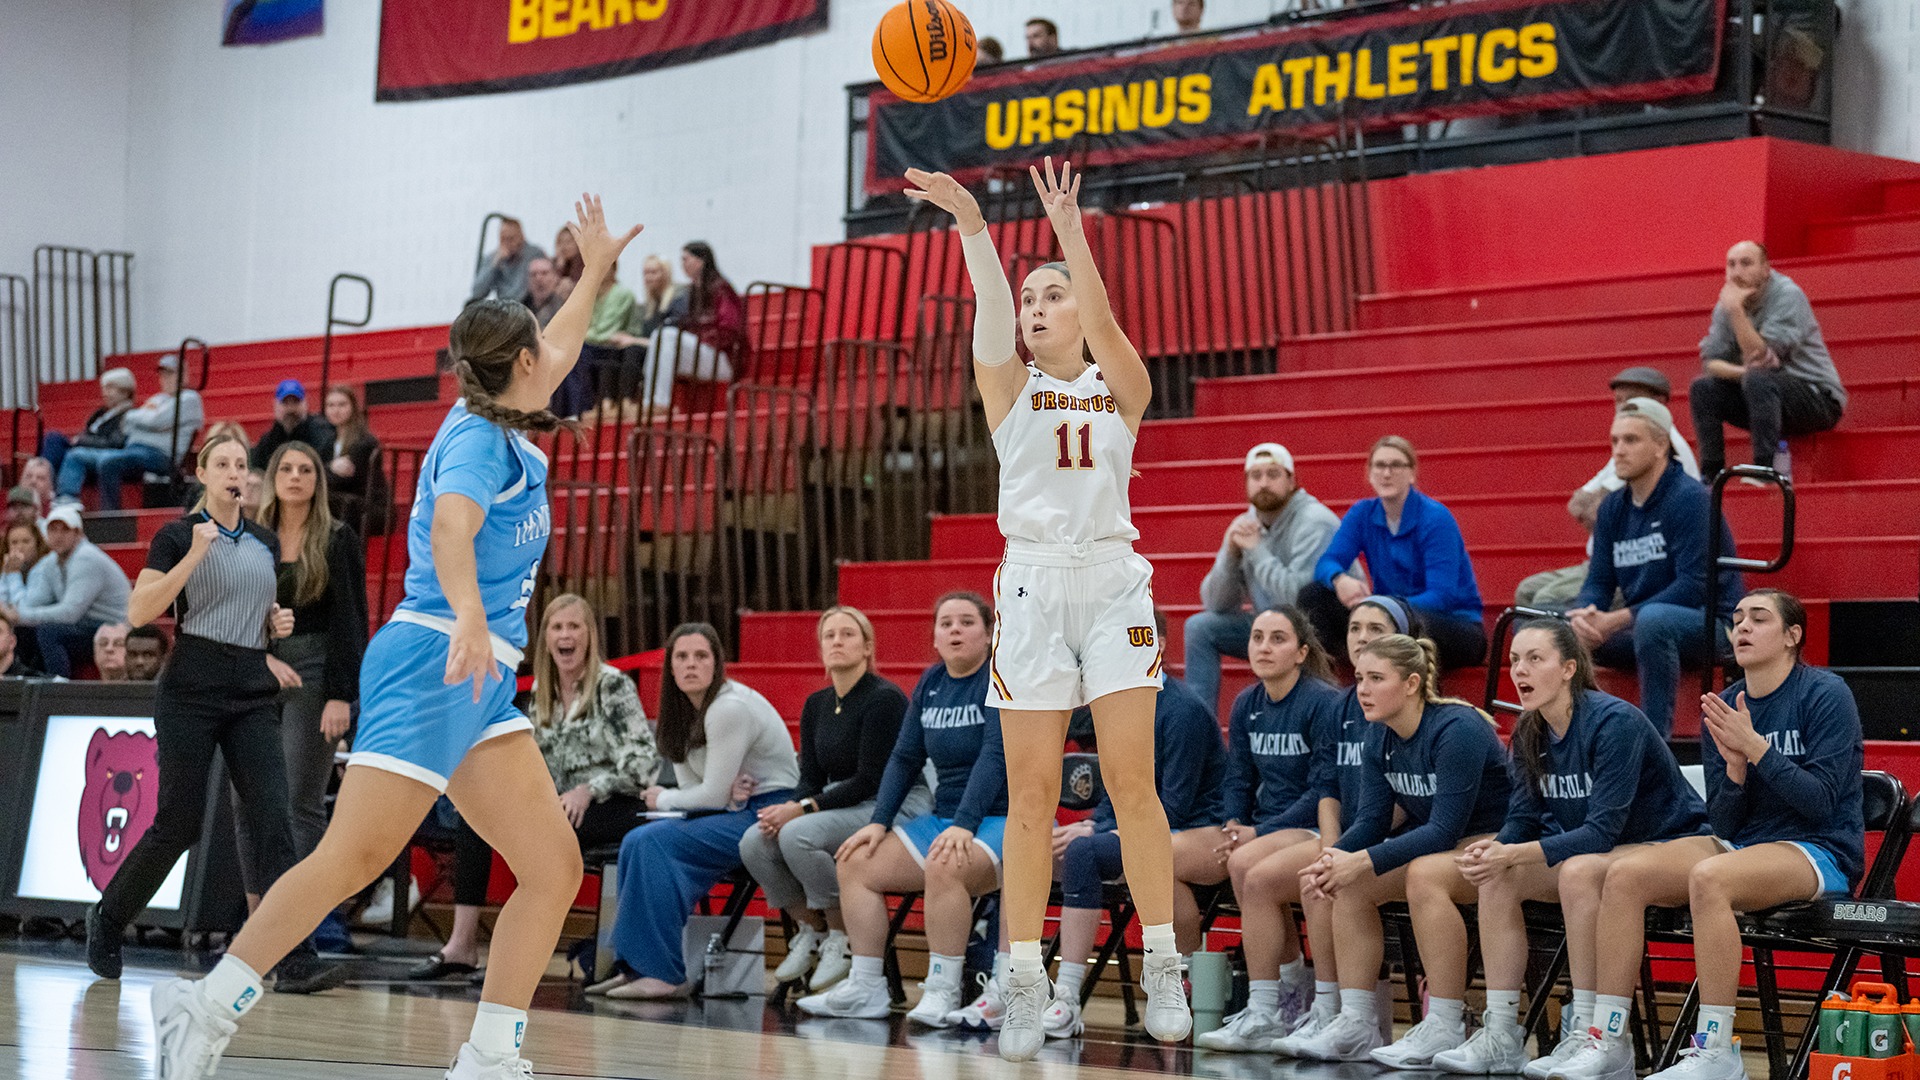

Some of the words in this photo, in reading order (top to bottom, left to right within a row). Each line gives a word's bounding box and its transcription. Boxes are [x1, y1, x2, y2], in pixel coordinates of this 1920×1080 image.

[985, 74, 1212, 150] URSINUS
[1247, 22, 1559, 116] ATHLETICS
[1031, 390, 1116, 414] URSINUS
[1054, 420, 1095, 470] 11
[1127, 625, 1154, 647] UC
[1833, 903, 1888, 923] BEARS
[1870, 1029, 1889, 1052] G
